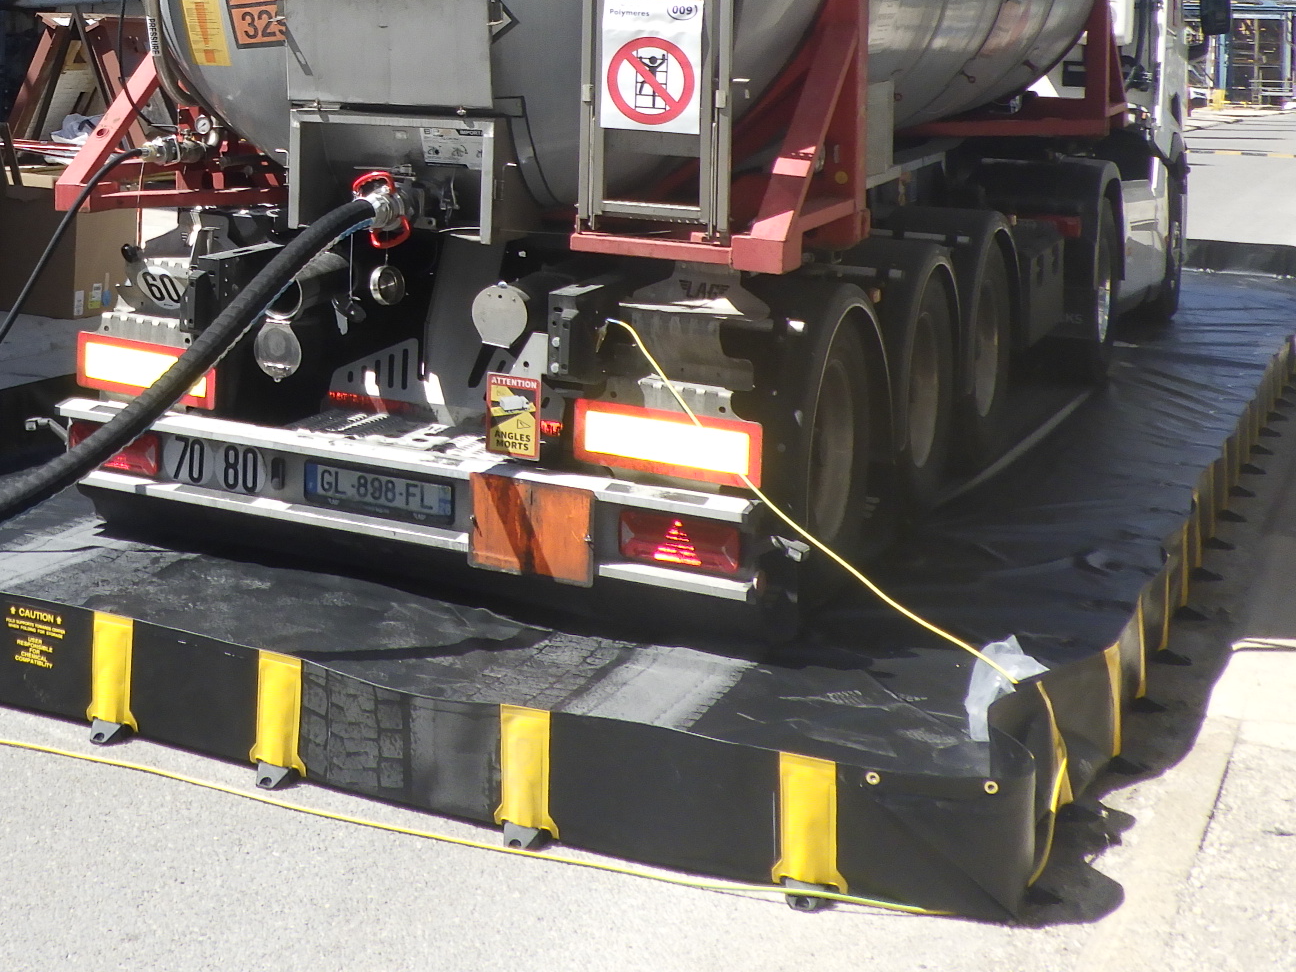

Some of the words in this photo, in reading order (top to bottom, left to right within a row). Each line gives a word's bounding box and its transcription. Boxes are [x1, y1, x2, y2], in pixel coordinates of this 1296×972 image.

[609, 8, 650, 18] Polymeres
[672, 5, 693, 16] 009
[148, 18, 160, 55] PRESSURE
[142, 271, 181, 304] 60
[491, 376, 537, 389] ATTENTION
[494, 430, 531, 443] ANGLES
[496, 439, 529, 451] MORTS
[173, 436, 204, 484] 70
[223, 445, 258, 493] 80
[320, 469, 434, 511] GL-898-FL
[18, 607, 54, 623] CAUTION
[27, 636, 42, 644] USER
[20, 650, 47, 662] CHEMICAL
